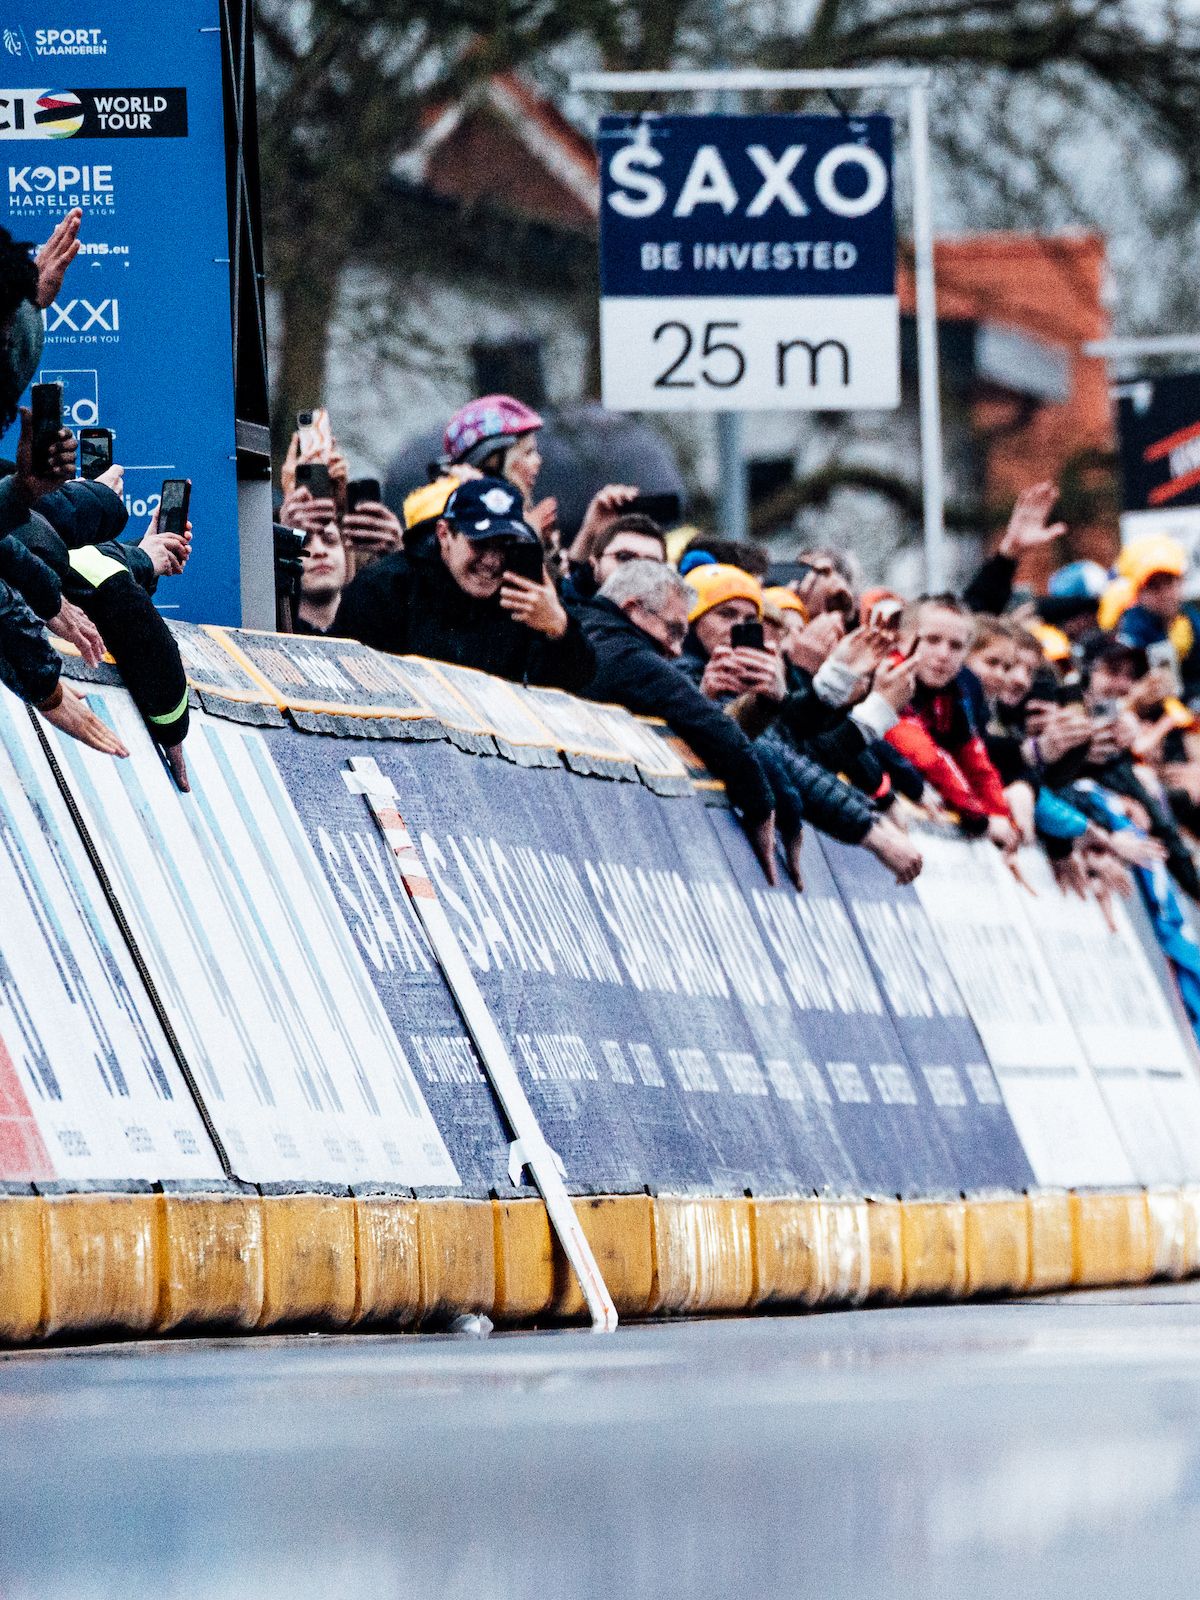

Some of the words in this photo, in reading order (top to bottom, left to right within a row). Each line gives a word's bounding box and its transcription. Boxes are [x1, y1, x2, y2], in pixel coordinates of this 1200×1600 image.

[35, 29, 107, 45] SPORT.
[35, 45, 107, 55] VLAANDEREN
[93, 96, 167, 113] WORLD
[97, 113, 152, 130] TOUR
[8, 165, 114, 192] KOPIE
[607, 142, 889, 218] SAXO
[9, 194, 115, 207] HARELBEKE
[640, 242, 683, 271] BE
[693, 242, 858, 270] INVESTED
[80, 335, 98, 343] FOR
[100, 335, 120, 343] YOU
[653, 321, 746, 389] 25
[776, 339, 850, 387] m
[318, 826, 440, 972] SAX
[426, 1035, 487, 1082] INVESTE
